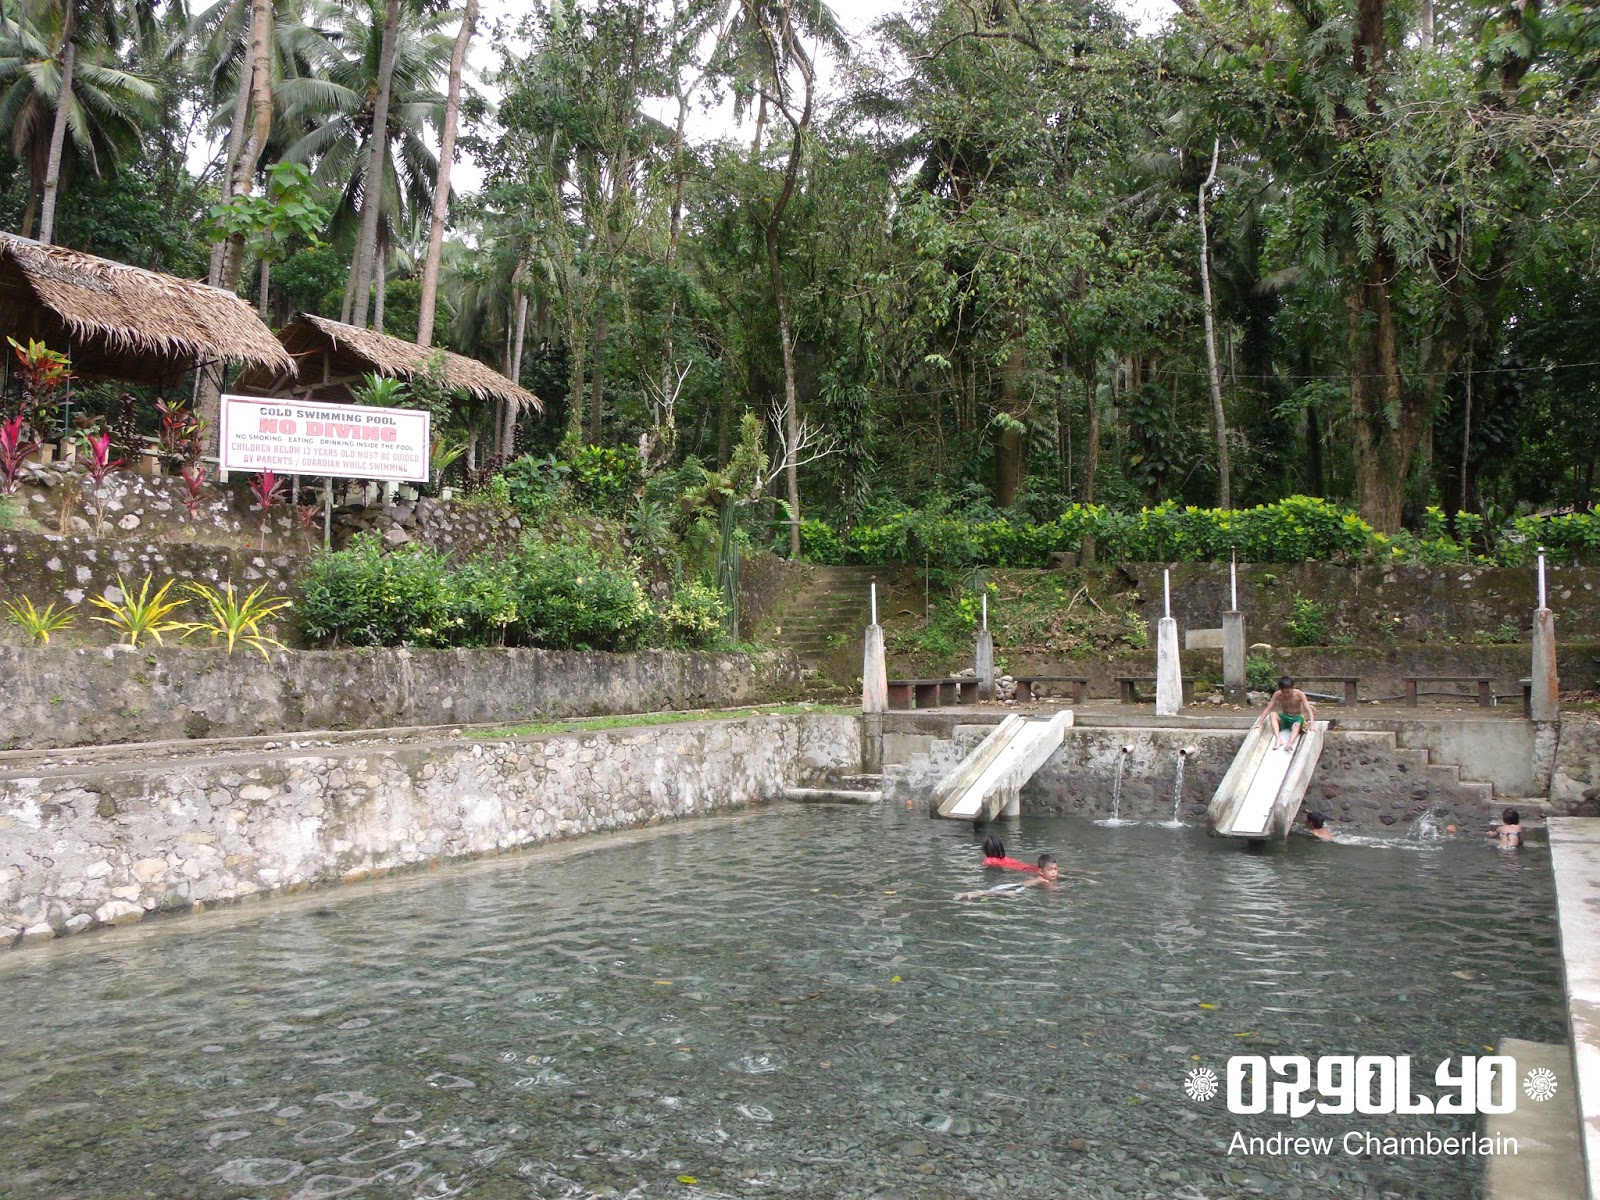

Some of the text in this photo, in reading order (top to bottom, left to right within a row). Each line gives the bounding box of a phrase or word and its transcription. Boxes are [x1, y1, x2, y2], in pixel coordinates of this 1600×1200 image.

[260, 407, 396, 425] COLD SWIMMING POOL
[259, 418, 397, 442] NO DIVING
[249, 434, 282, 442] SMOKING
[320, 439, 354, 447] DRINKING
[231, 443, 419, 462] CHILDREN BELOW 13 YEARS OLD MUST BE GUIDED
[244, 455, 253, 463] BY
[256, 456, 293, 465] PARENTS
[302, 458, 340, 468] GUARDIAN
[342, 461, 367, 469] WHILE
[369, 463, 408, 472] SWIMMING
